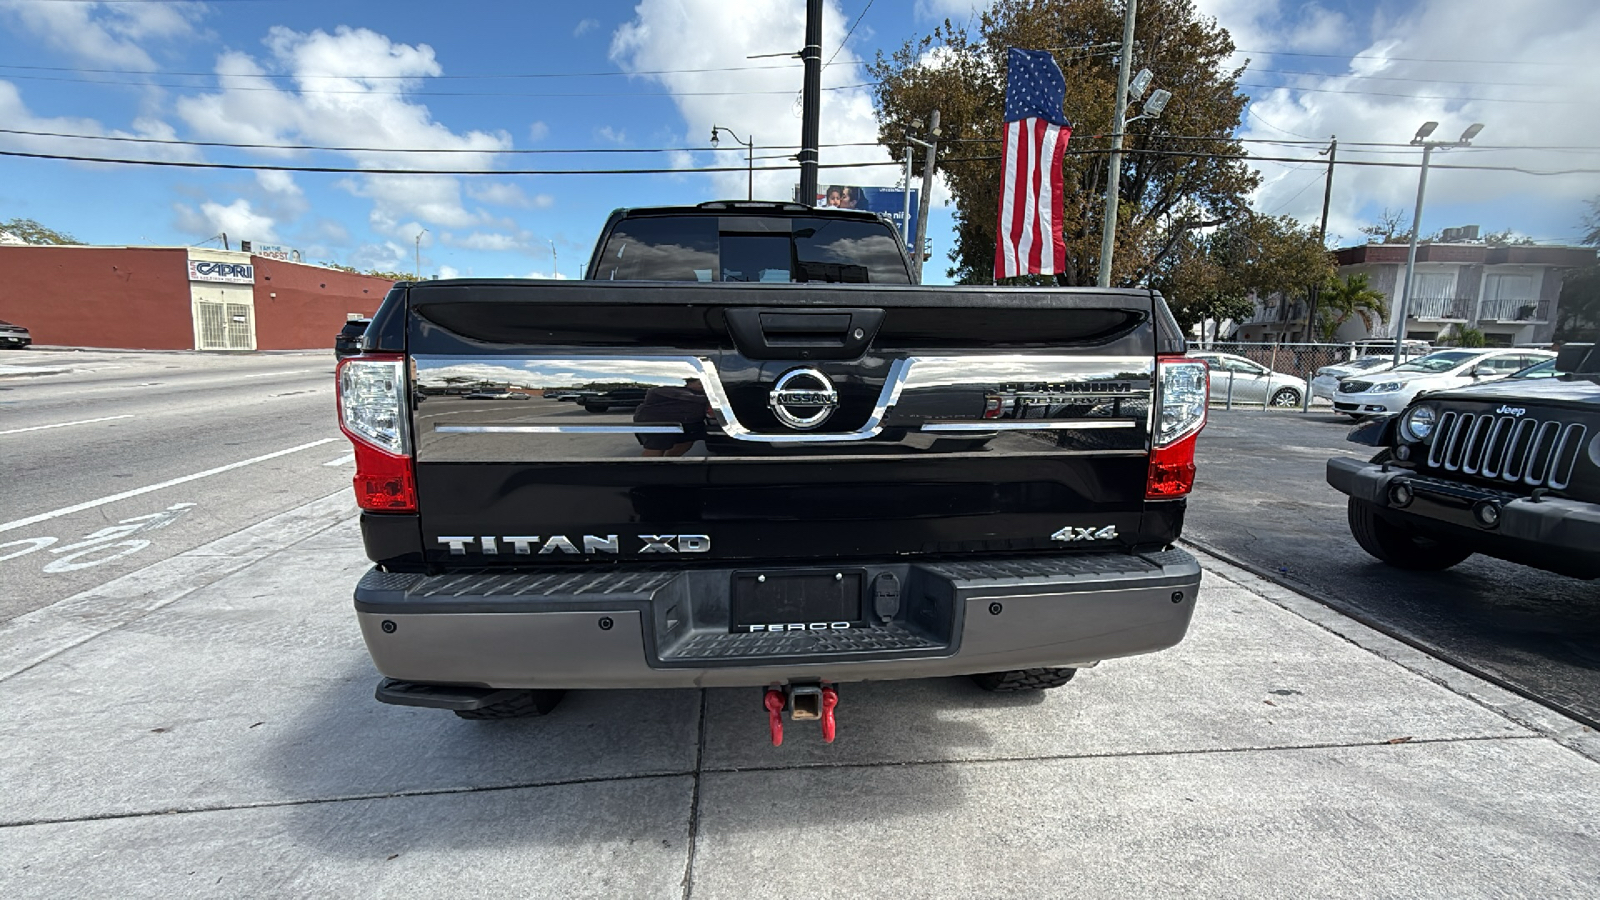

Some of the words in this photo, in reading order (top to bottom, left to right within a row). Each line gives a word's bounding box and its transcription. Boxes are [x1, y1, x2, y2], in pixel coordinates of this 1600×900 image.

[197, 262, 252, 279] CAPRI
[1000, 382, 1131, 393] PLATINUM
[777, 393, 831, 404] NISSAN
[1496, 404, 1526, 417] Jeep
[437, 534, 620, 555] TITAN
[637, 534, 711, 554] XD
[750, 621, 850, 632] FERCO
